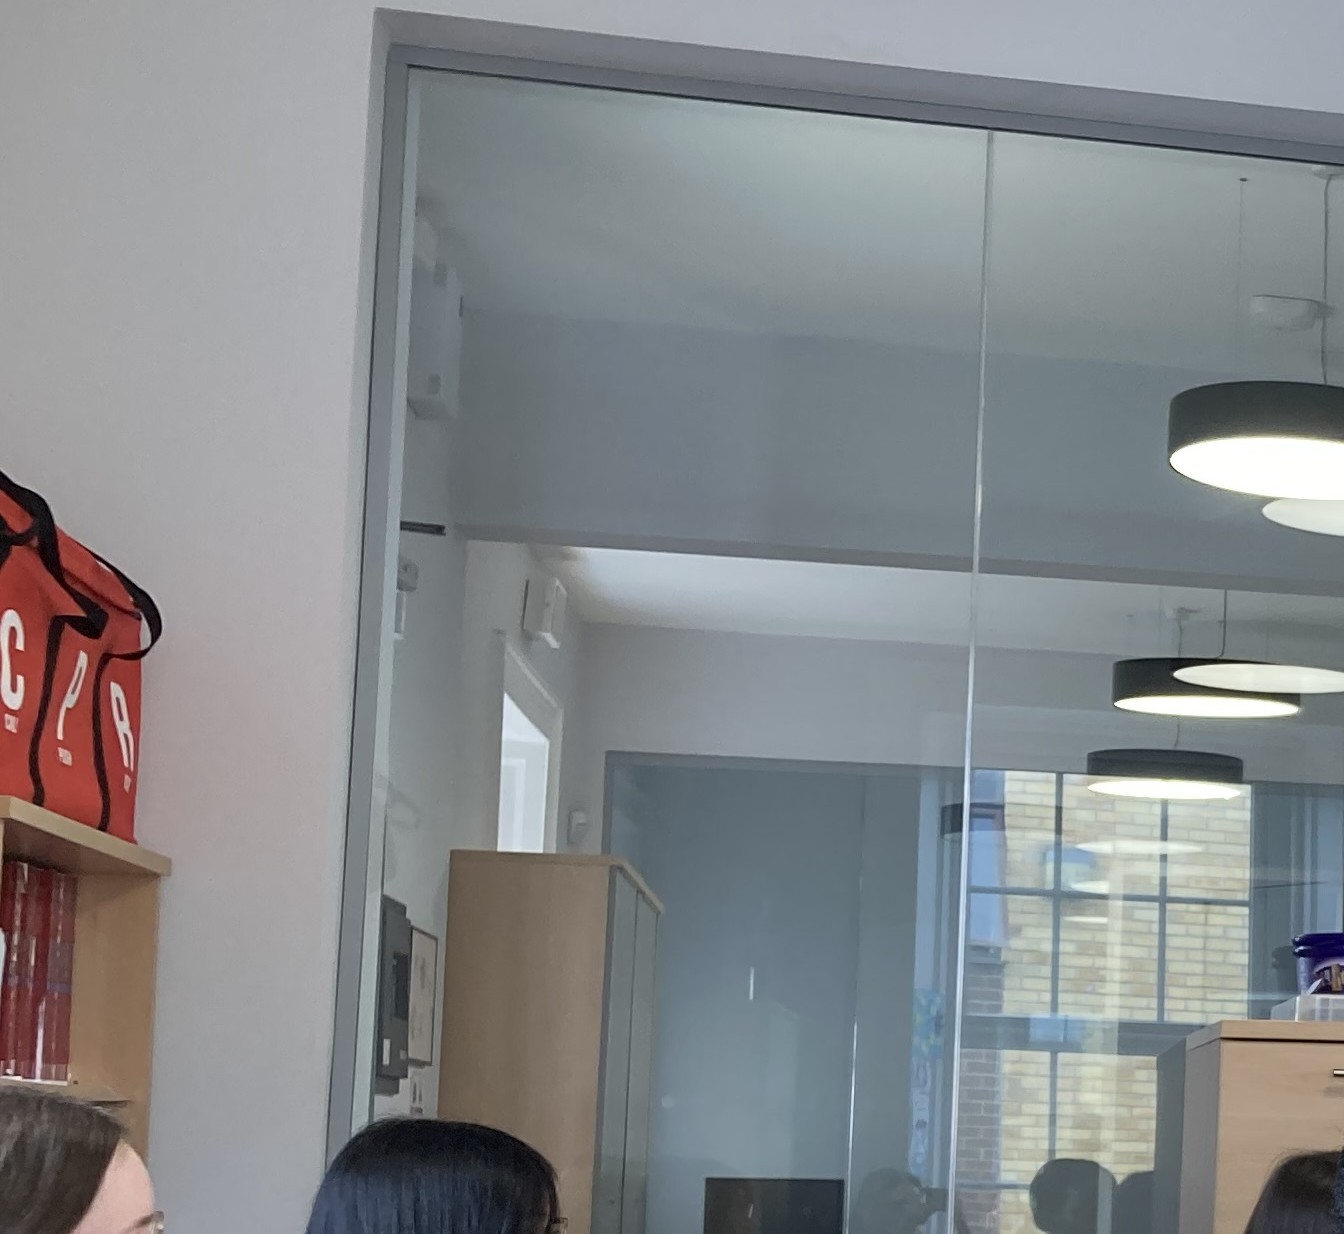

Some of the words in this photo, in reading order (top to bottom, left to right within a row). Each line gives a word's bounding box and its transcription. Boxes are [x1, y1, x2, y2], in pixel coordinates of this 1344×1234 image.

[0, 609, 26, 711] C
[56, 650, 89, 741] P
[109, 681, 135, 772] R
